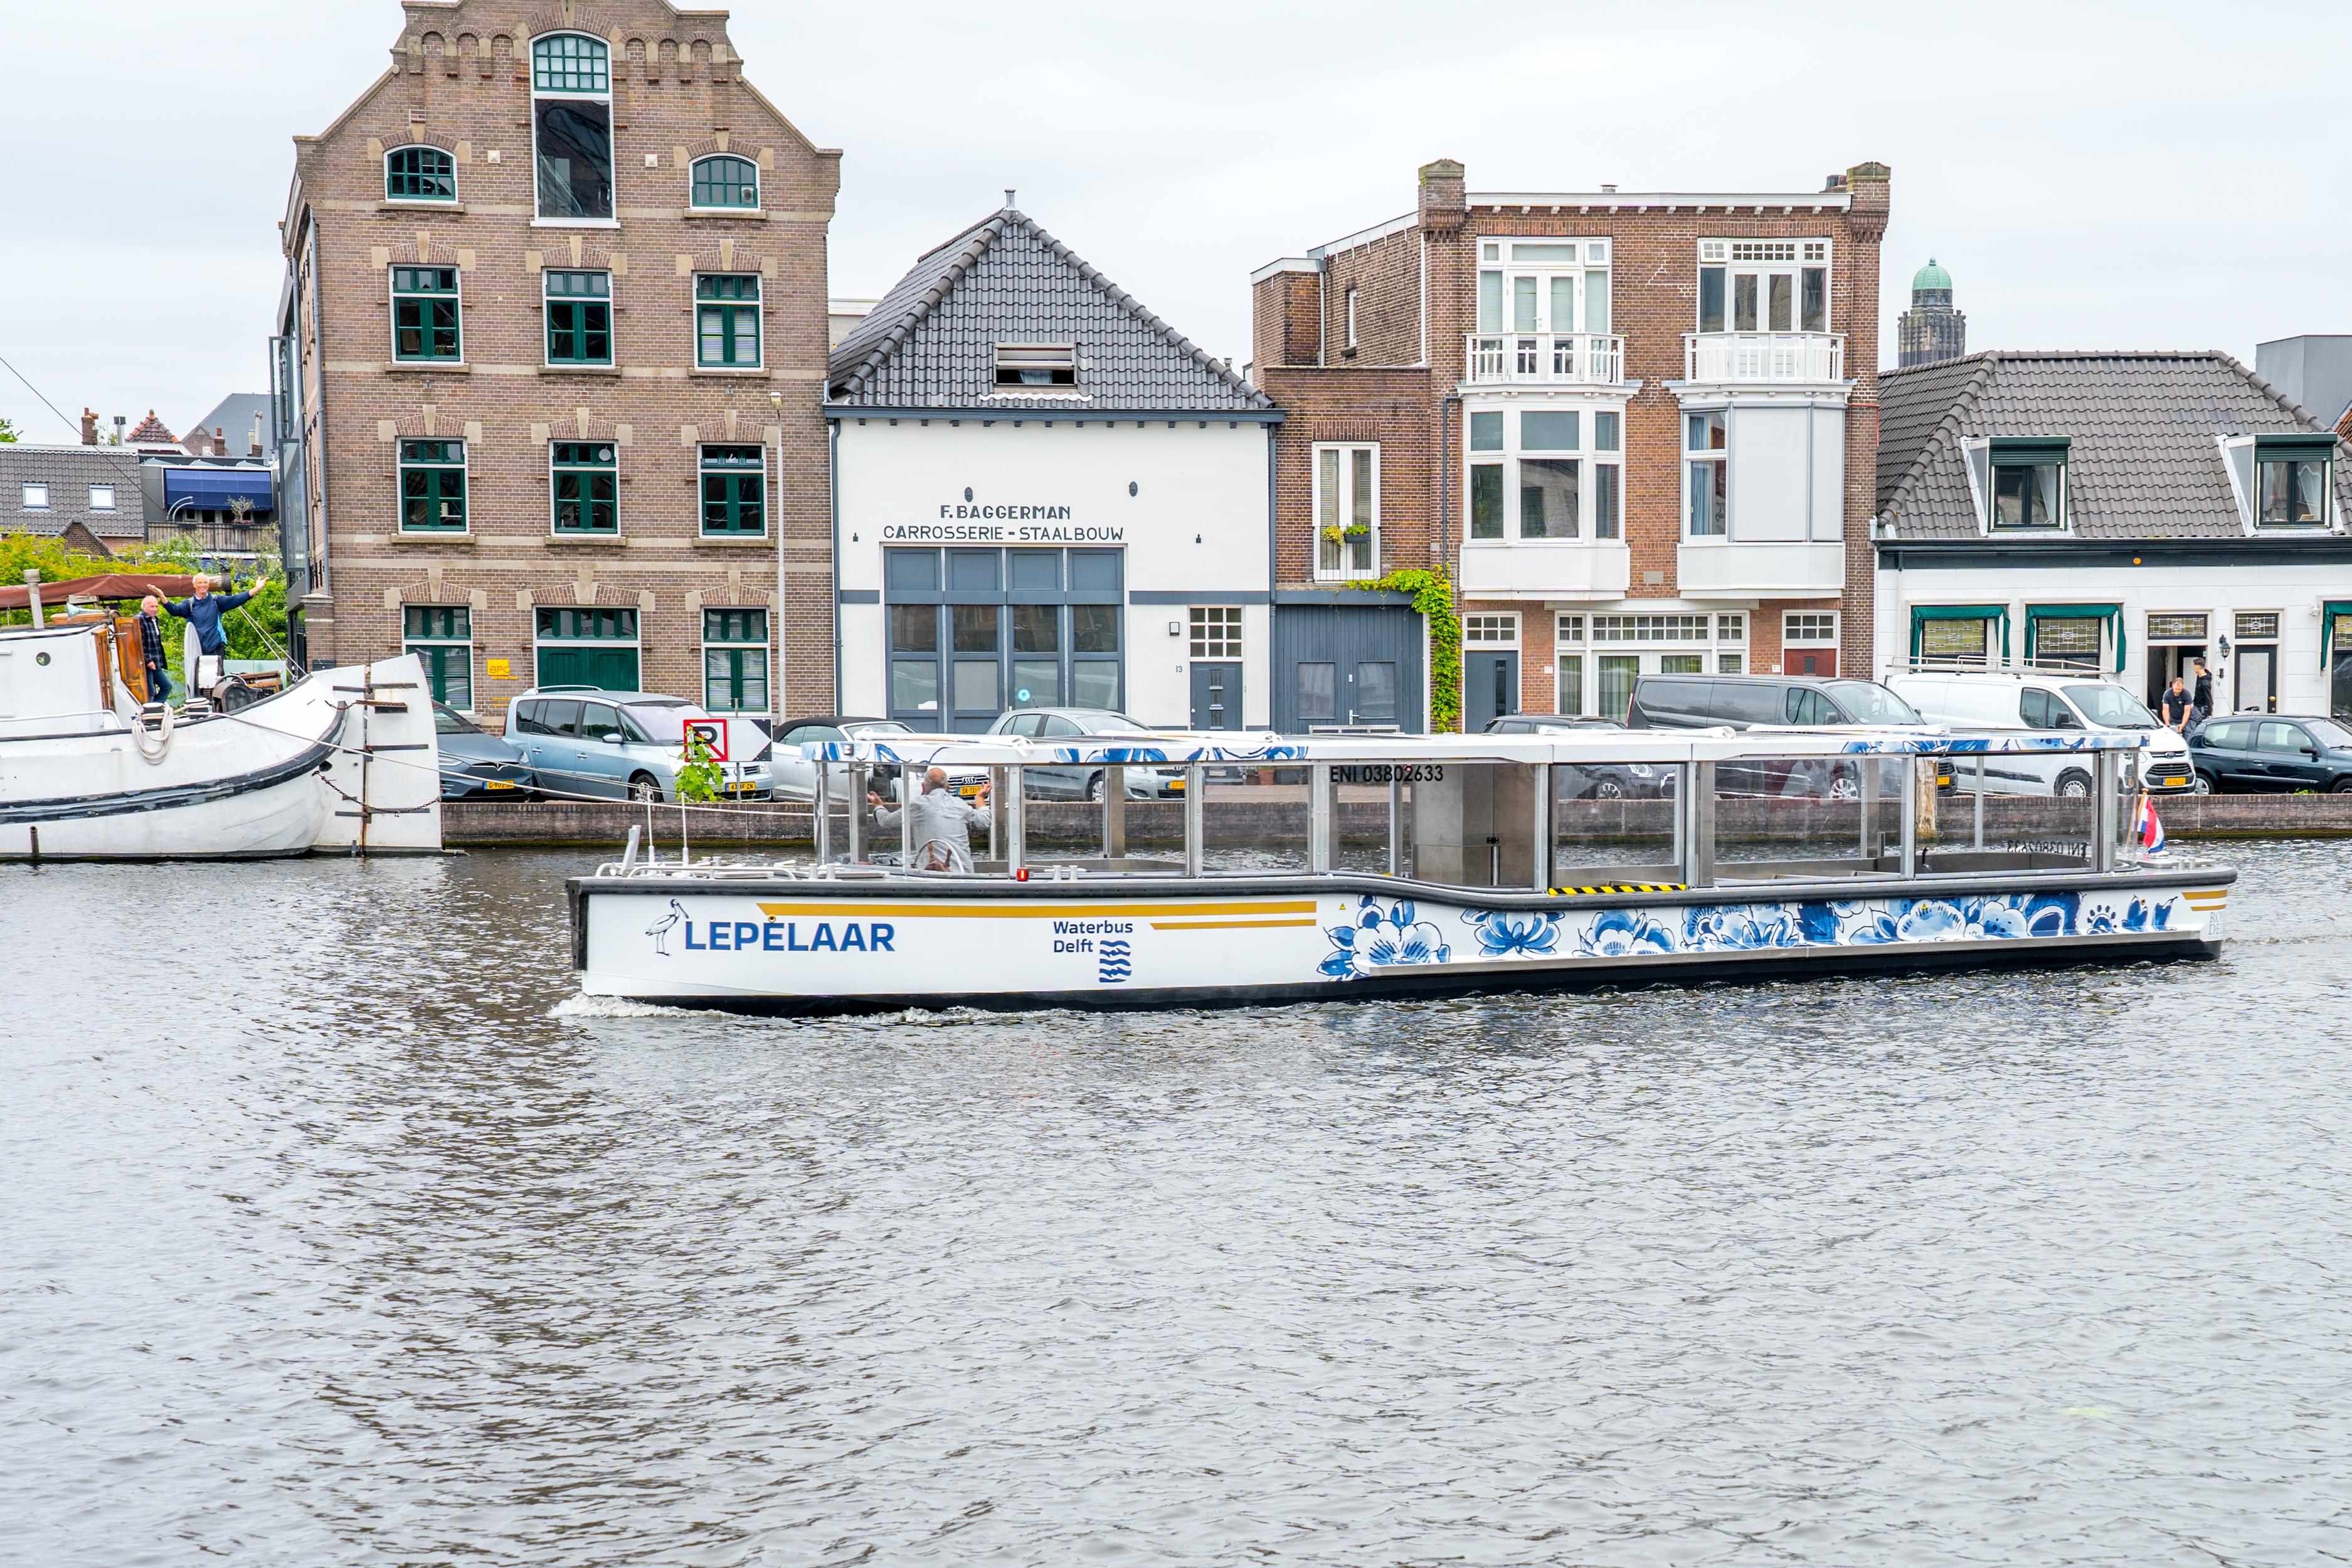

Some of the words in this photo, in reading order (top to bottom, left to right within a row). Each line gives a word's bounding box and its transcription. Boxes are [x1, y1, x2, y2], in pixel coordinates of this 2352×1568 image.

[883, 525, 1004, 539] CARROSSERIE
[1019, 527, 1124, 541] STAALBOUW
[1175, 665, 1183, 673] 13
[1330, 766, 1357, 782] ENI
[1363, 765, 1443, 782] 03802633
[1053, 919, 1133, 935] Waterbus
[685, 921, 896, 952] LEPELAAR
[1053, 938, 1094, 953] Delft
